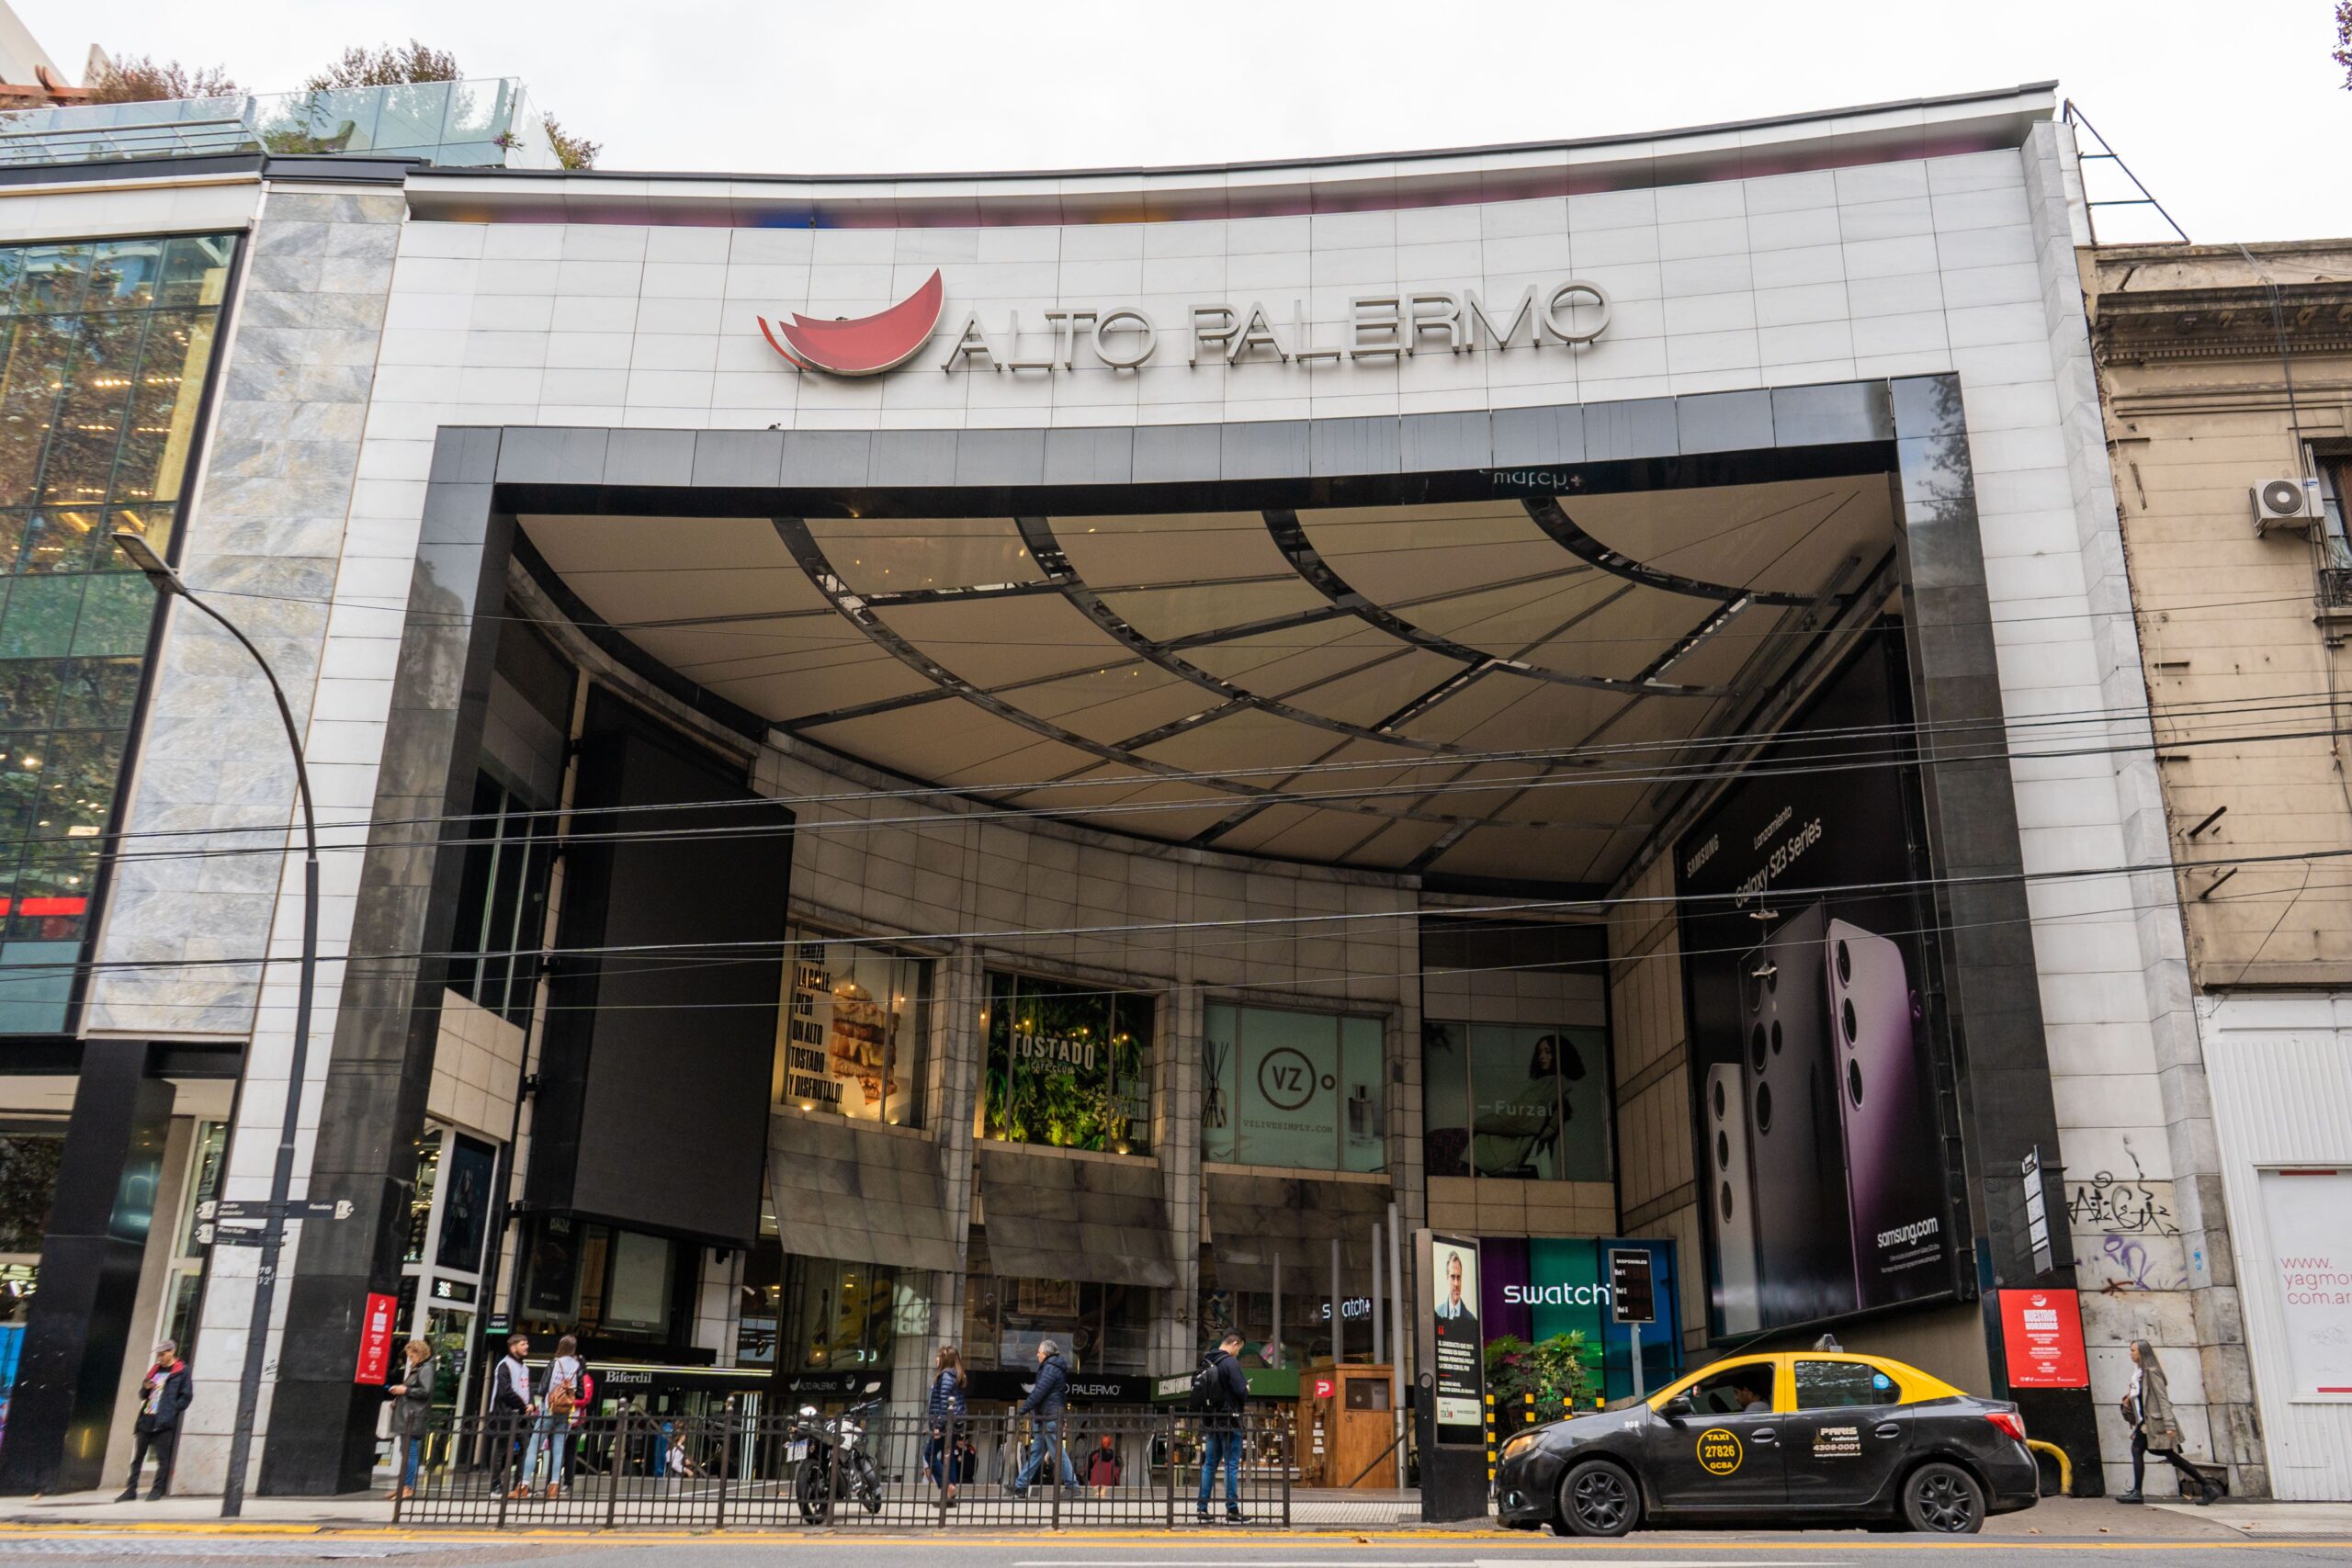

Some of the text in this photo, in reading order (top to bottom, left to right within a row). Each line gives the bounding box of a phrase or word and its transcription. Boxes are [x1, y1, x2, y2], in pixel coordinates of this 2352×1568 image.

[941, 279, 1611, 370] ALTO PALERMO
[1754, 806, 1792, 851] Lanzamiento
[1687, 834, 1719, 878] SAMSUNG
[1736, 818, 1822, 908] Galaxy S23 Series
[797, 966, 807, 988] LA
[793, 1020, 823, 1045] UN ALTO
[790, 1046, 825, 1074] TOSTADO
[1013, 1032, 1094, 1071] TOSTADO
[788, 1073, 843, 1104] Y DISFRUTALO!
[1272, 1066, 1302, 1091] VZ
[1877, 1217, 1939, 1248] samsung.com
[2280, 1258, 2334, 1269] www.
[1504, 1283, 1610, 1305] swatch
[2283, 1273, 2352, 1291] yagmo
[1322, 1296, 1366, 1319] satch
[2287, 1292, 2351, 1304] com.ar
[605, 1370, 652, 1383] Biferdil
[1072, 1384, 1120, 1395] PALERMO
[1820, 1427, 1858, 1436] PARIS
[1704, 1445, 1735, 1458] 27826
